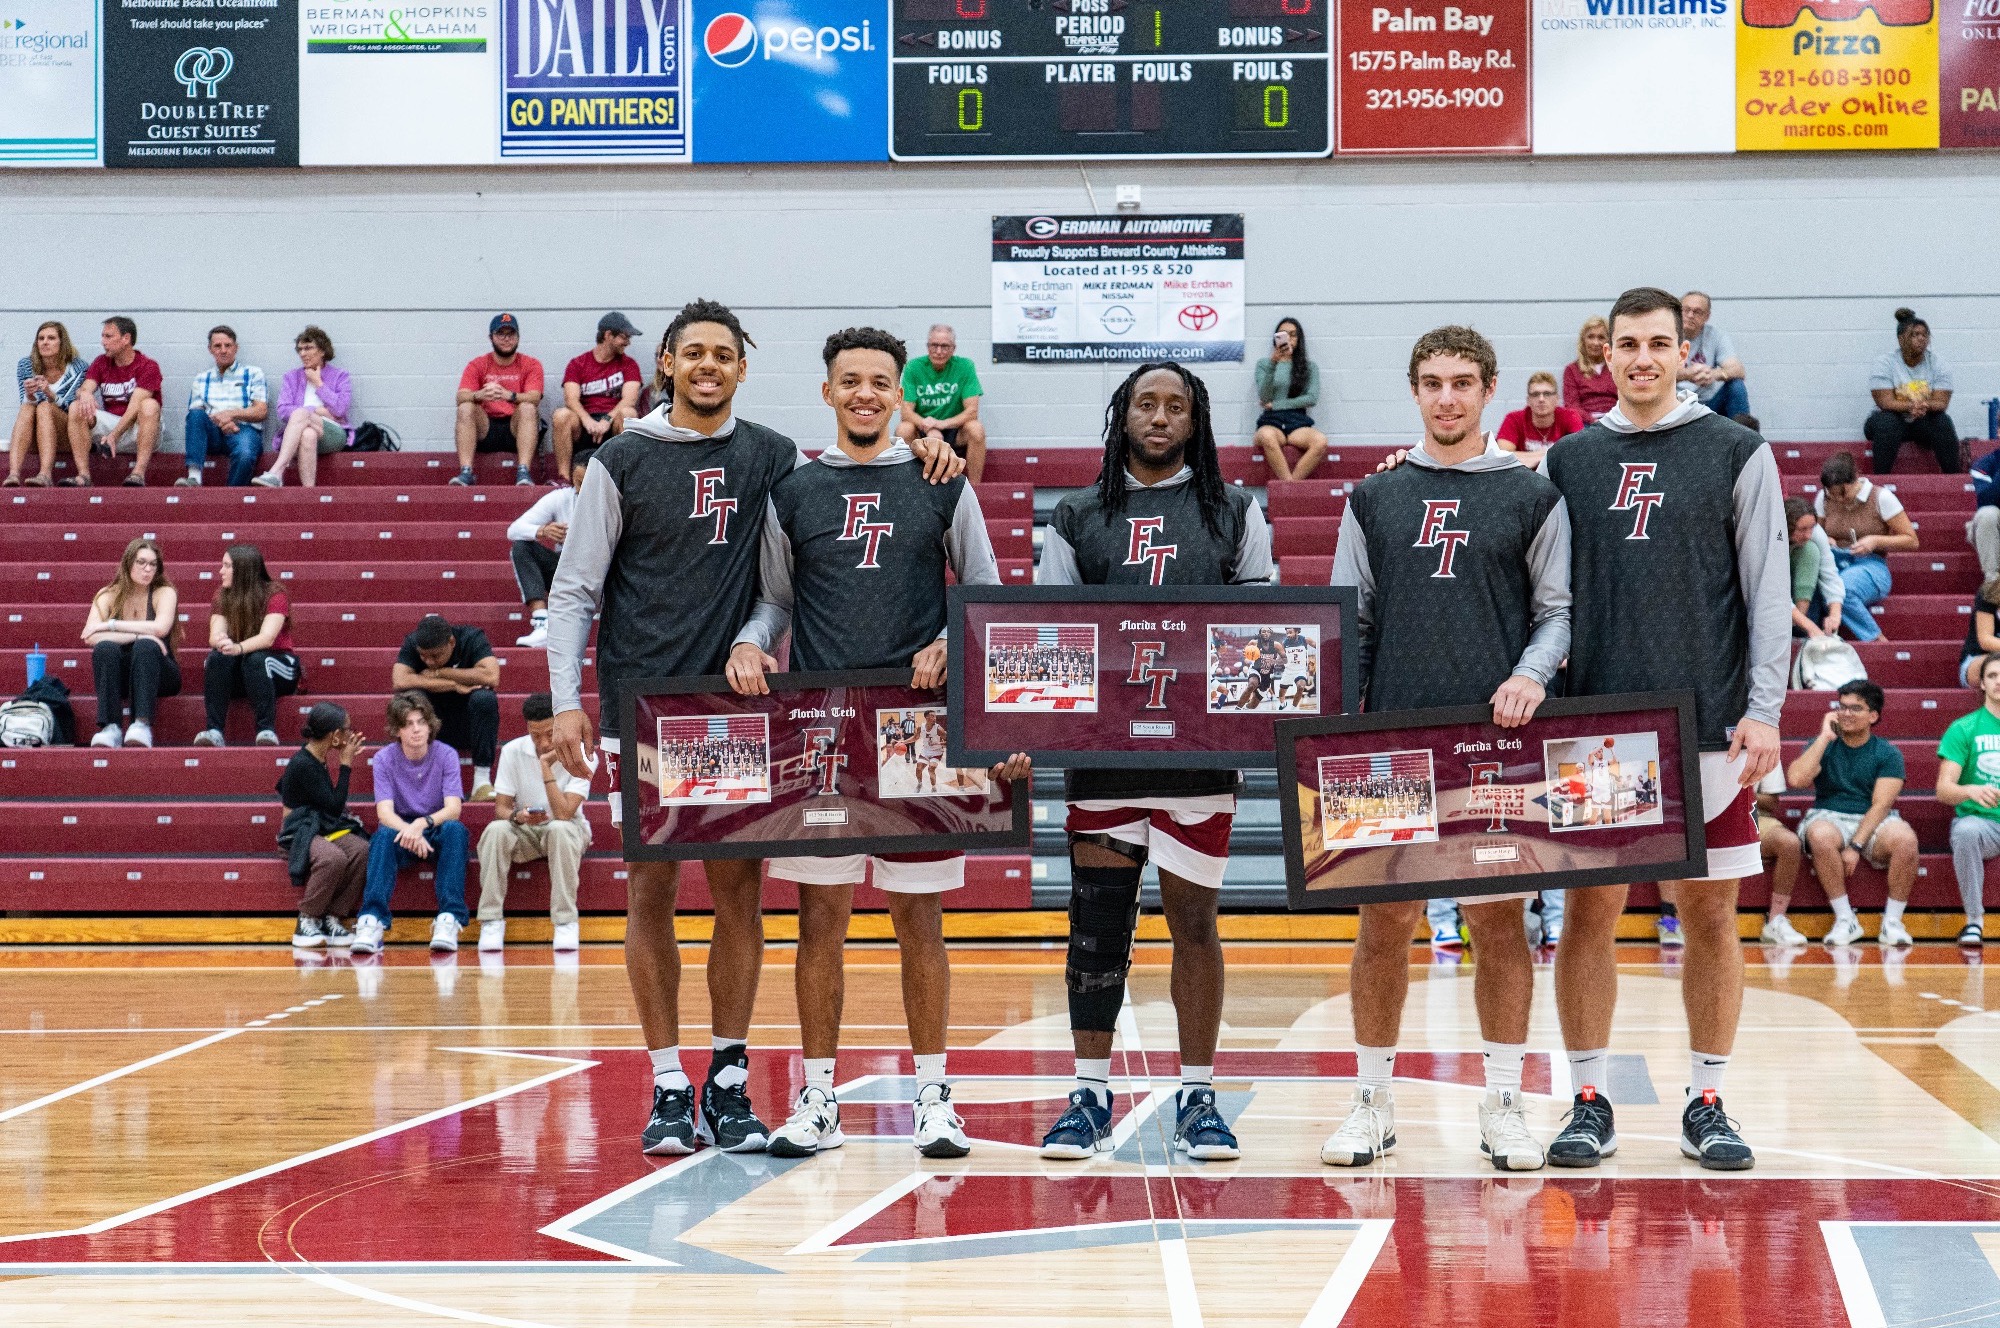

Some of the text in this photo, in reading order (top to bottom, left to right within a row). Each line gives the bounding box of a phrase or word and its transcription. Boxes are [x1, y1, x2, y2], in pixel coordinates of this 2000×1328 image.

[307, 8, 385, 20] BERMAN
[405, 7, 487, 19] HOPKINS
[1372, 6, 1494, 36] Palm Bay
[130, 18, 159, 29] Travel
[160, 18, 192, 29] should
[193, 18, 214, 29] take
[215, 20, 233, 31] you
[310, 23, 477, 35] WRIGHT LAHAM
[1055, 15, 1125, 35] PERIOD
[1541, 18, 1644, 30] CONSTRUCTION
[15, 30, 88, 53] regional
[514, 0, 667, 77] DAILY
[764, 19, 871, 60] pepsi
[937, 29, 1002, 49] BONUS
[1218, 26, 1283, 46] BONUS
[1793, 25, 1881, 56] Pizza
[1349, 49, 1516, 73] 1575 Palm Bay Rd.
[928, 65, 988, 84] FOULS
[1045, 62, 1193, 82] PLAYER FOULS
[1233, 61, 1294, 81] FOULS
[1759, 68, 1911, 87] 321-608-3100
[1263, 85, 1289, 127] 0
[1365, 88, 1504, 109] 321-956-1900
[1745, 92, 1929, 116] Order Online
[510, 97, 675, 126] GO PANTHERS!
[958, 88, 983, 130] 0
[1784, 123, 1888, 137] marcos.com
[1060, 220, 1213, 234] ERDMAN AUTOMOTIVE
[1011, 244, 1227, 259] Proudly Supports Brevard County Athletics
[1043, 264, 1193, 276] Located at I-95 & 520
[1003, 280, 1073, 291] Mike Erdman
[1082, 282, 1153, 290] MIKE ERDMAN
[1163, 279, 1233, 289] Mike Erdman
[1025, 344, 1205, 359] ErdmanAutomotive.com
[916, 382, 959, 397] CASCO
[1119, 620, 1187, 632] Florida Tech
[788, 706, 856, 720] Florida Tech
[1453, 738, 1522, 755] Florida Tech
